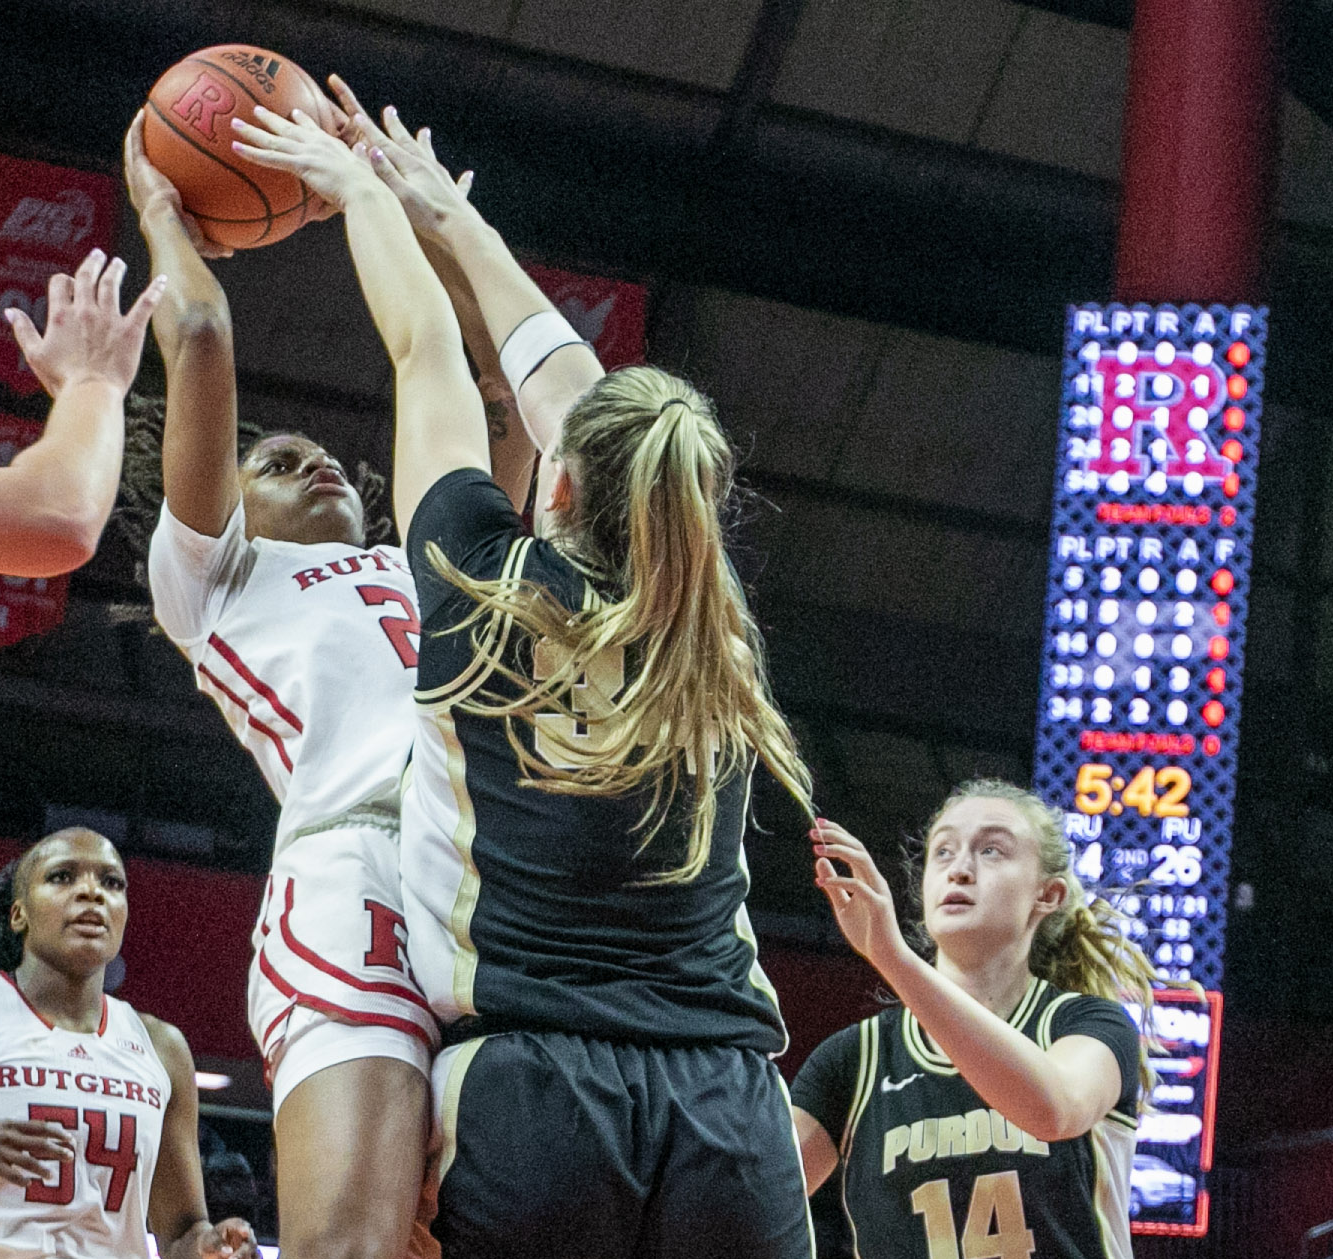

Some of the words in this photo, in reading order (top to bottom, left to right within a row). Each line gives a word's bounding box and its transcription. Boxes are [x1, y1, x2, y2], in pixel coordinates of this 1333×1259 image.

[221, 51, 276, 96] adidas
[170, 70, 236, 142] R
[1155, 312, 1179, 336] R
[1193, 313, 1216, 337] A
[1230, 313, 1252, 337] F
[292, 553, 414, 591] RUT
[1138, 538, 1163, 563] R
[1177, 538, 1200, 565] A
[1214, 538, 1236, 565] F
[354, 584, 421, 670] 2
[1075, 763, 1191, 818] 5:42
[1161, 817, 1202, 845] PU
[1069, 841, 1103, 882] 4
[1149, 843, 1203, 886] 26
[23, 1101, 142, 1212] 54
